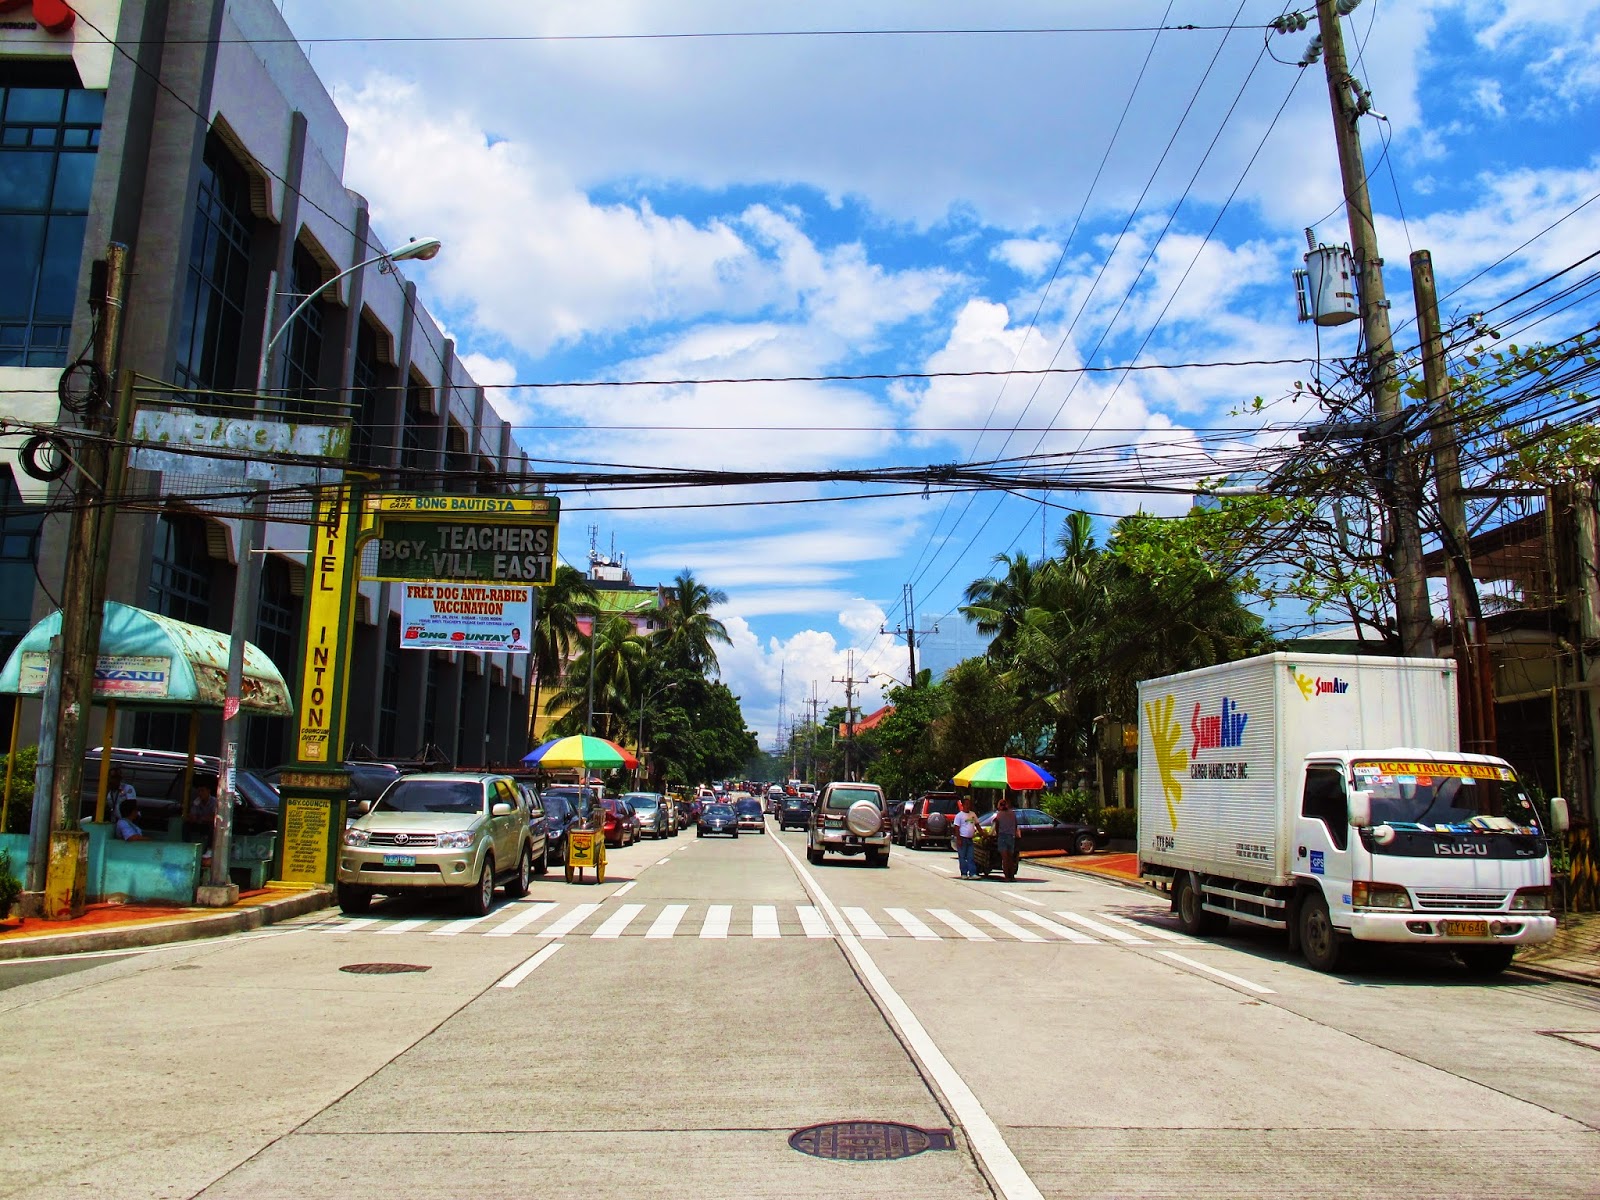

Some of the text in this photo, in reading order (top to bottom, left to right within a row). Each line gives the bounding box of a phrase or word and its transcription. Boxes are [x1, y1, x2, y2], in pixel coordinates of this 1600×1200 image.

[416, 497, 514, 512] BONG BAUTISTA
[437, 526, 548, 552] TEACHERS
[381, 540, 550, 580] BGY. VILL. EAST
[407, 586, 528, 602] FREE DOG ANTI-RABIES
[433, 600, 503, 615] VACCINATION
[404, 630, 510, 642] BONG SUNTAY
[95, 670, 161, 680] YANI
[308, 627, 329, 727] INTON
[1316, 676, 1348, 696] SunAir
[1191, 697, 1248, 760] SunAir
[1191, 764, 1208, 779] CARGO
[1208, 763, 1236, 779] HANDLERS
[1414, 764, 1457, 773] TRUCK
[1460, 766, 1501, 776] CENTE
[1433, 844, 1488, 855] ISUZU
[1450, 922, 1486, 932] TYV 646
